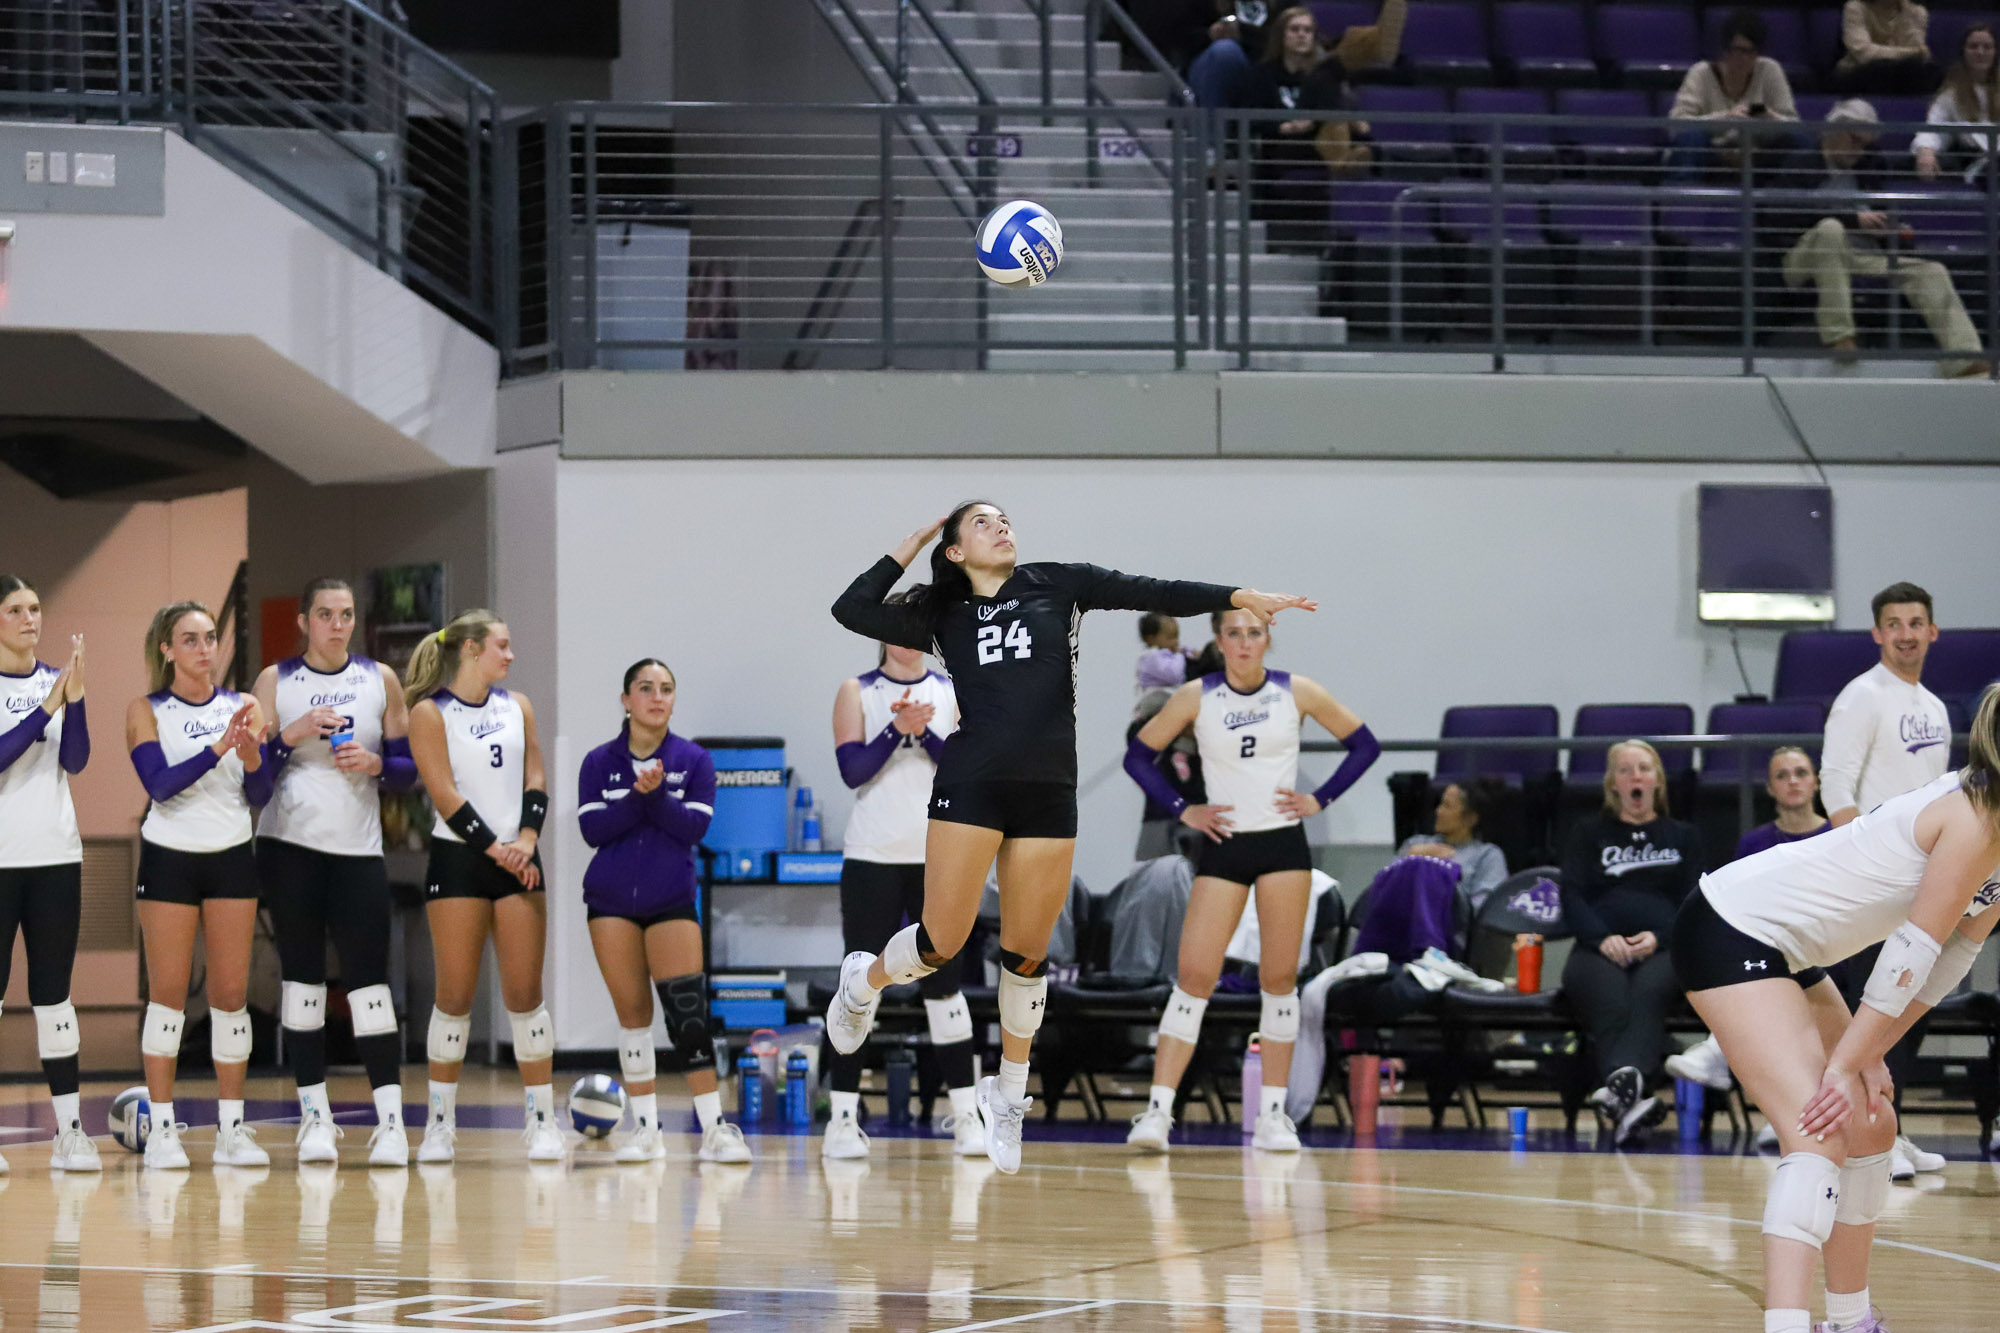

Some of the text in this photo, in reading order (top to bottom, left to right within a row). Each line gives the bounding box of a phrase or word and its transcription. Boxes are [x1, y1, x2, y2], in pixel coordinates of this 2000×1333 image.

[1103, 140, 1136, 157] 120
[1020, 247, 1045, 283] molten
[1033, 240, 1057, 273] NCAA
[977, 619, 1032, 666] 24
[1223, 710, 1270, 730] Abilene
[489, 743, 504, 769] 3
[1240, 735, 1257, 759] 2
[716, 769, 782, 786] OWERADE
[1601, 842, 1682, 877] Abilene
[1513, 892, 1560, 920] ACU
